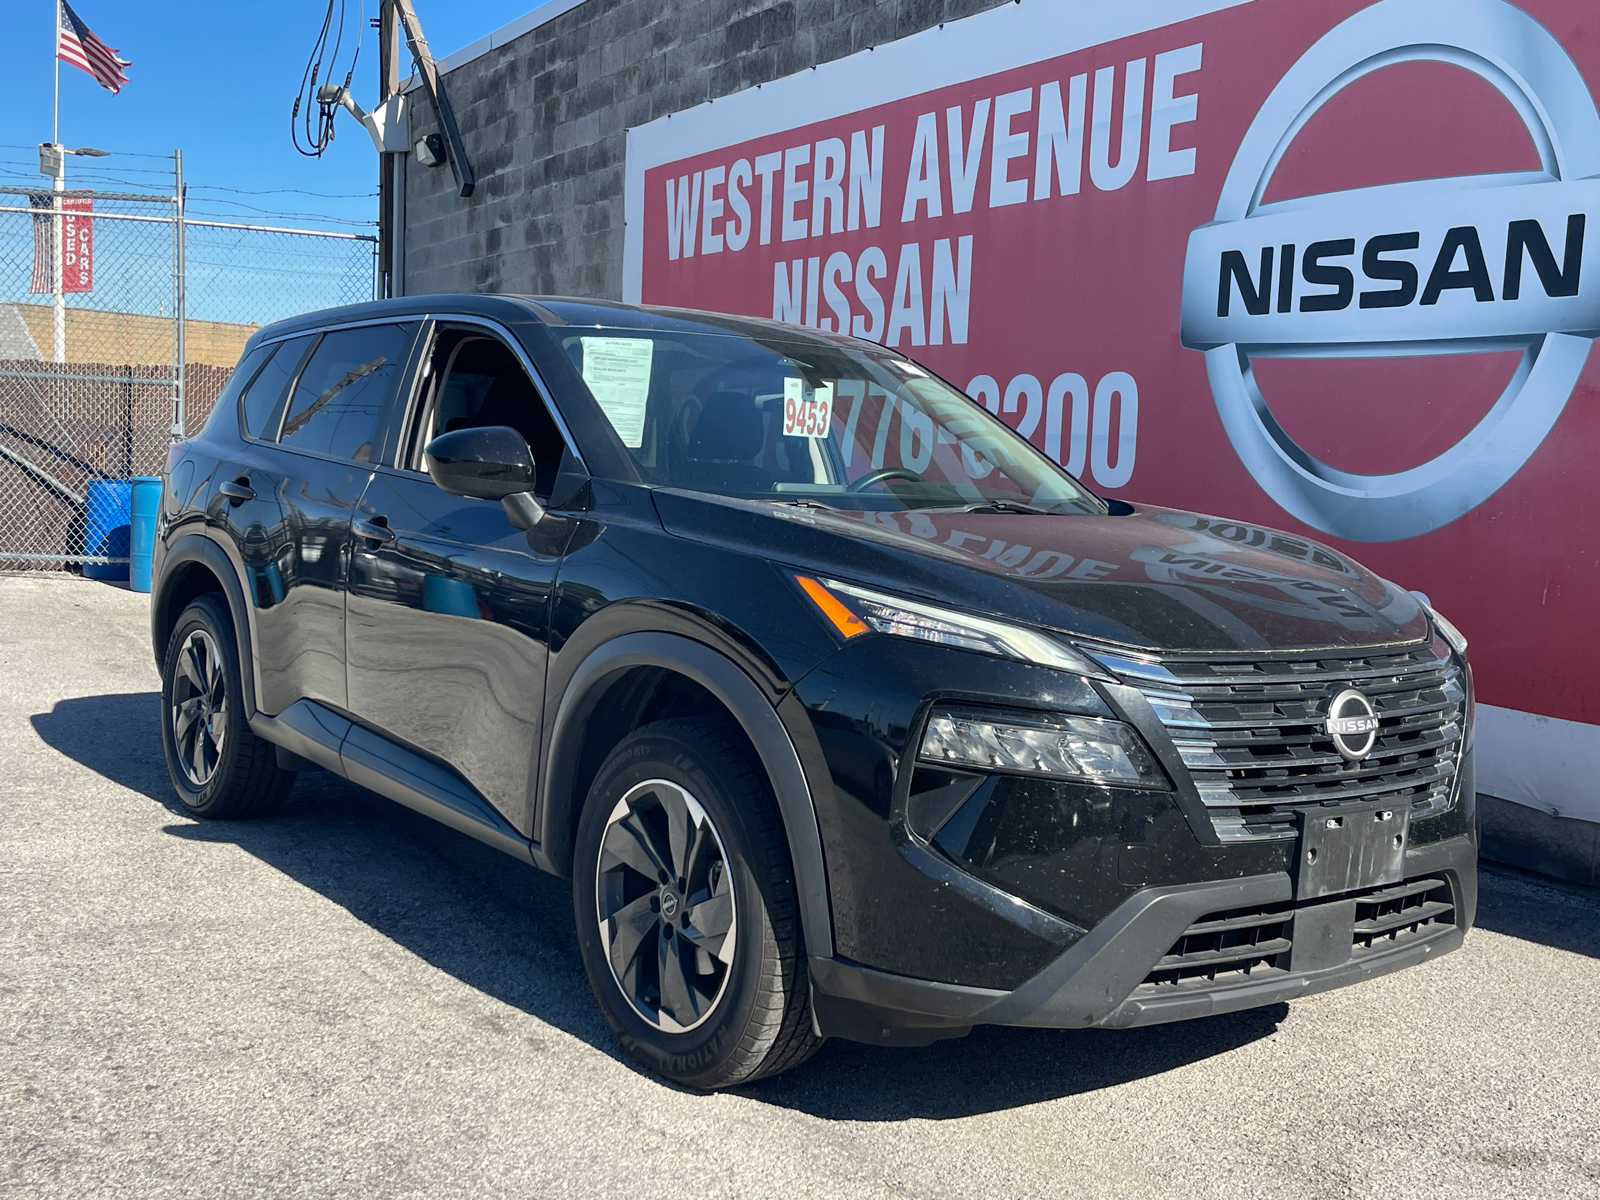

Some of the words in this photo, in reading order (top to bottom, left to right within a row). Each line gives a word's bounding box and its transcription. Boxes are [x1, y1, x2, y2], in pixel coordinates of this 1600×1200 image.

[665, 125, 885, 262] WESTERN
[901, 42, 1203, 223] AVENUE
[79, 228, 89, 285] CARS
[773, 234, 974, 347] NISSAN
[1217, 213, 1586, 318] NISSAN
[785, 398, 828, 436] 9453
[1329, 718, 1378, 732] NISSAN
